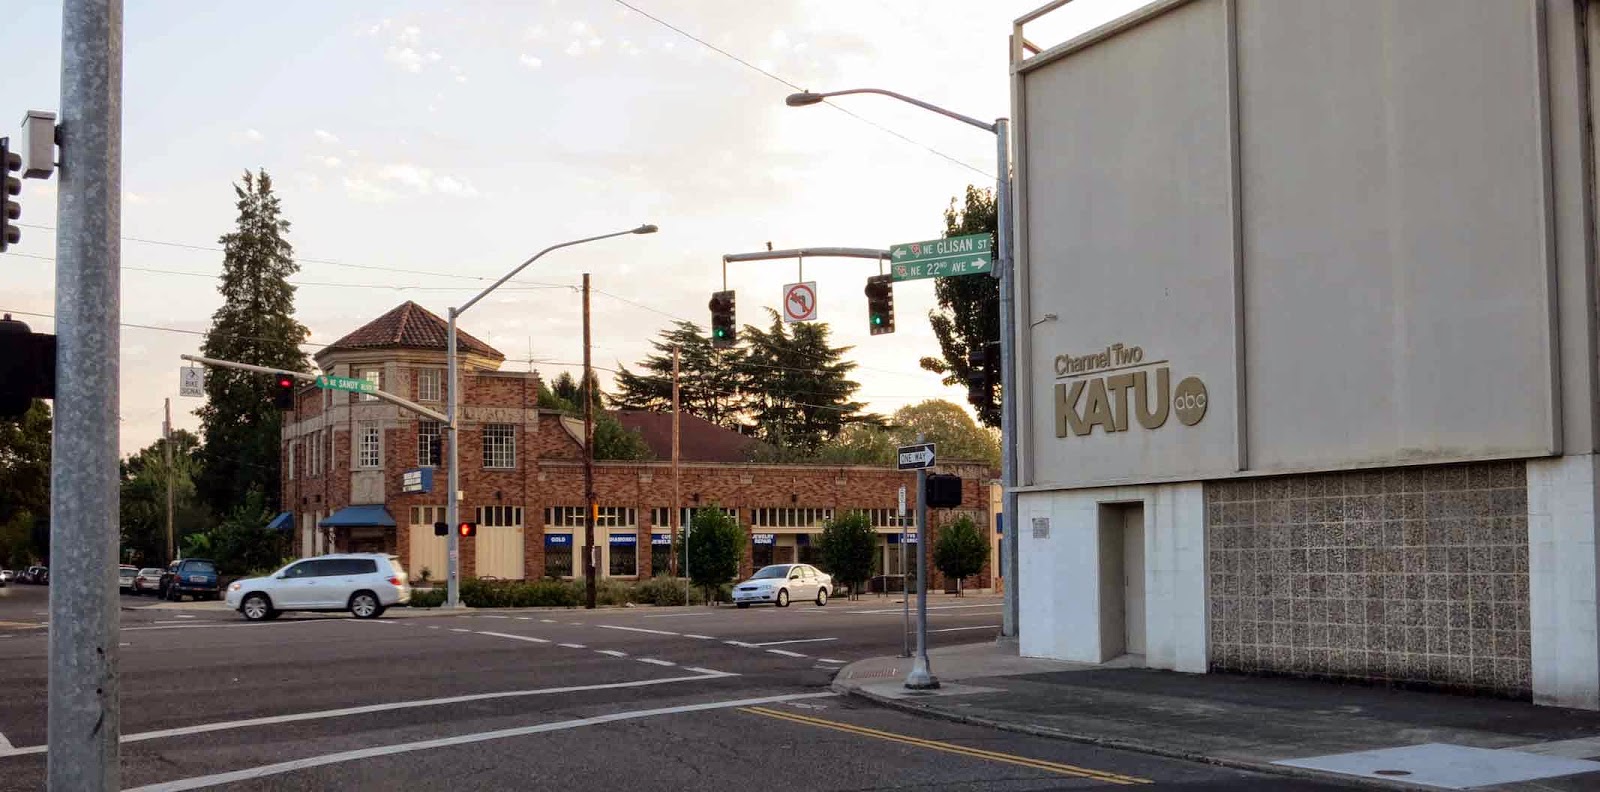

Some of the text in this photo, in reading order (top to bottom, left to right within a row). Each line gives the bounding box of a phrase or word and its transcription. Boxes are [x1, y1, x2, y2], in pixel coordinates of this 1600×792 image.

[923, 238, 987, 254] NE GLISAN ST
[910, 261, 967, 276] NE 22ND AVE
[1055, 342, 1144, 376] Channel Two
[338, 379, 358, 389] SANDY
[1055, 367, 1170, 438] KATU
[1175, 391, 1207, 410] abc
[901, 452, 926, 463] ONE WAY
